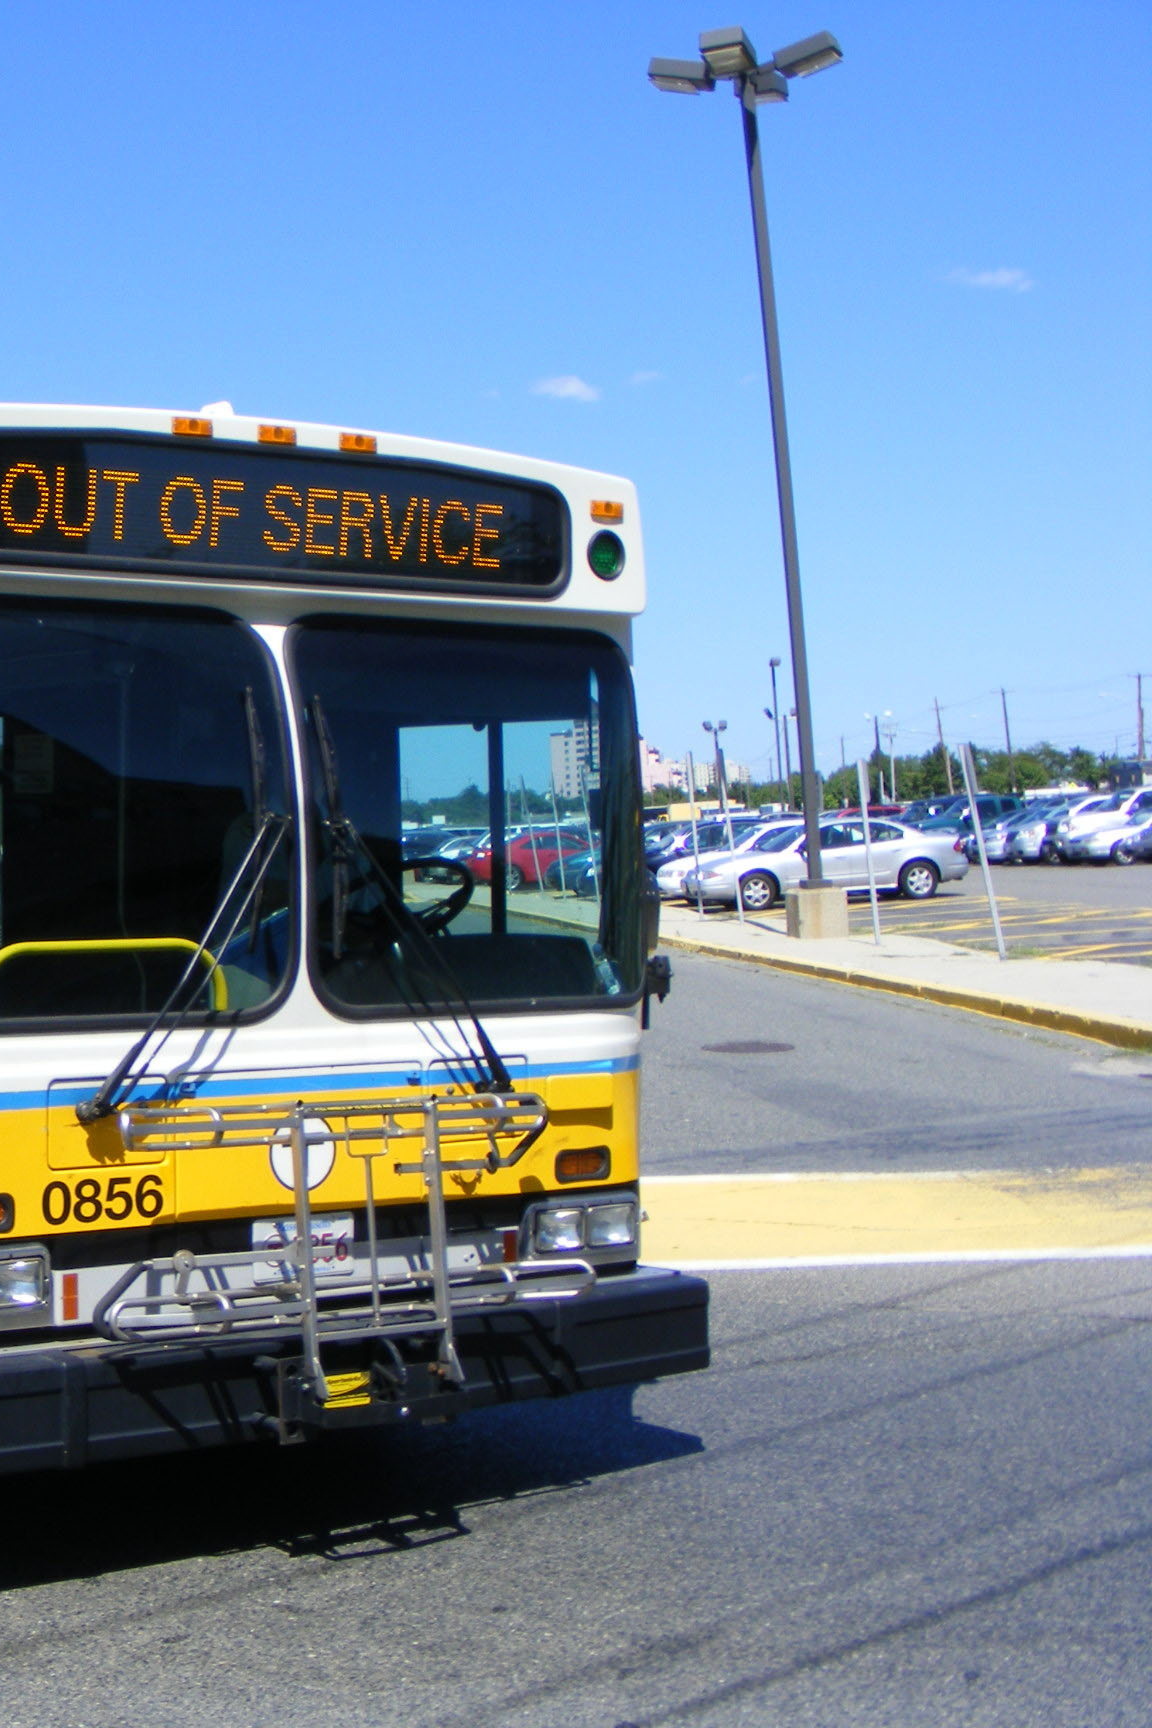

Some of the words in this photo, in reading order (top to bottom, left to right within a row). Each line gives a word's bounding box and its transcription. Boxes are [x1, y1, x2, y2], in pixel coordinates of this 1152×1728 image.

[0, 462, 140, 542] OUT
[159, 475, 245, 549] OF
[262, 484, 504, 569] SERVICE
[41, 1174, 164, 1226] 0856
